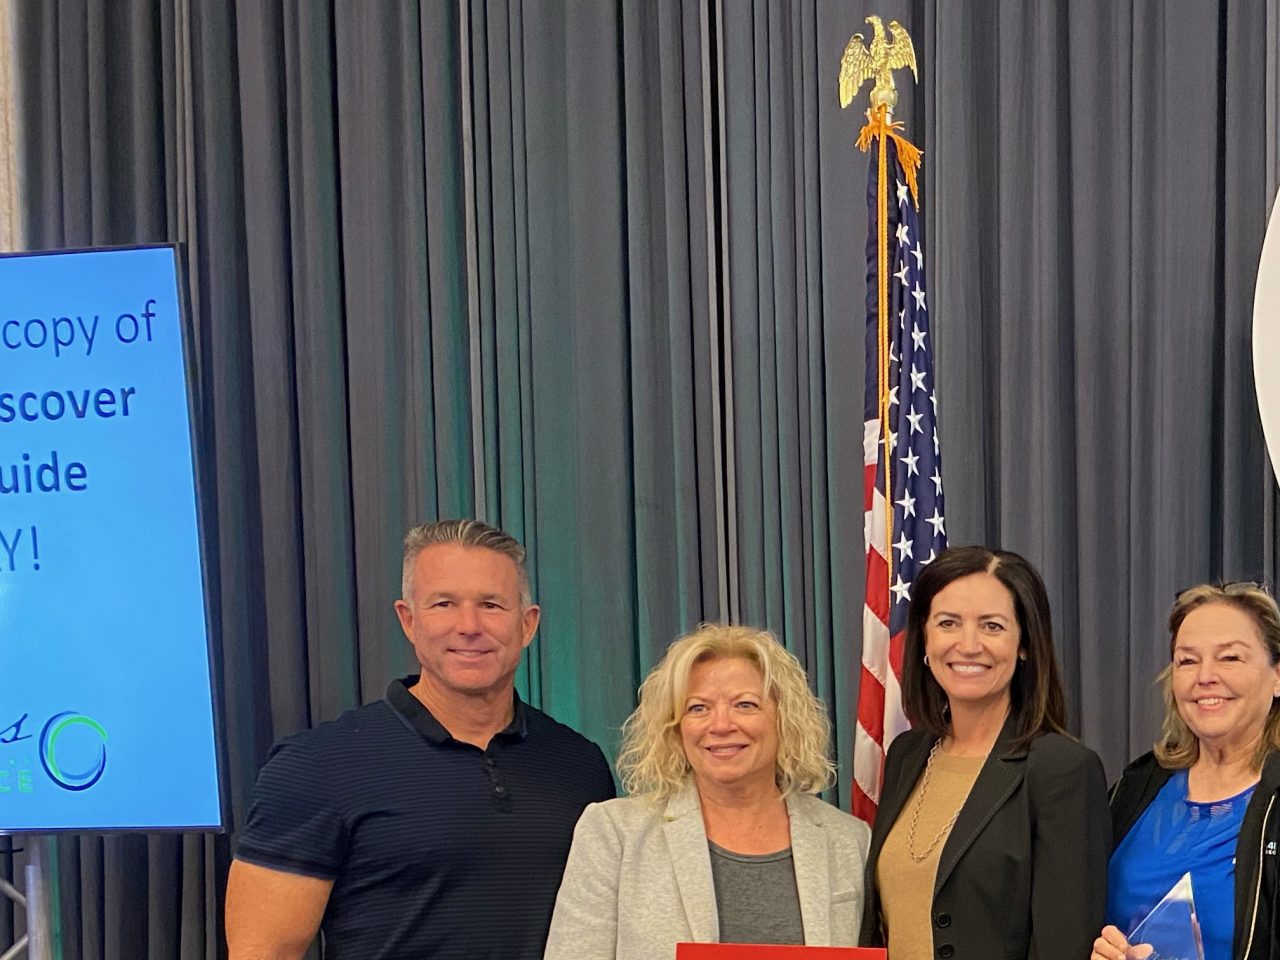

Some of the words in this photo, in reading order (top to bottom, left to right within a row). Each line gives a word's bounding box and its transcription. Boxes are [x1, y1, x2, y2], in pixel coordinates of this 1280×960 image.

[2, 314, 99, 358] copy
[115, 298, 157, 344] of
[0, 386, 136, 423] scover
[0, 525, 41, 572] Y!
